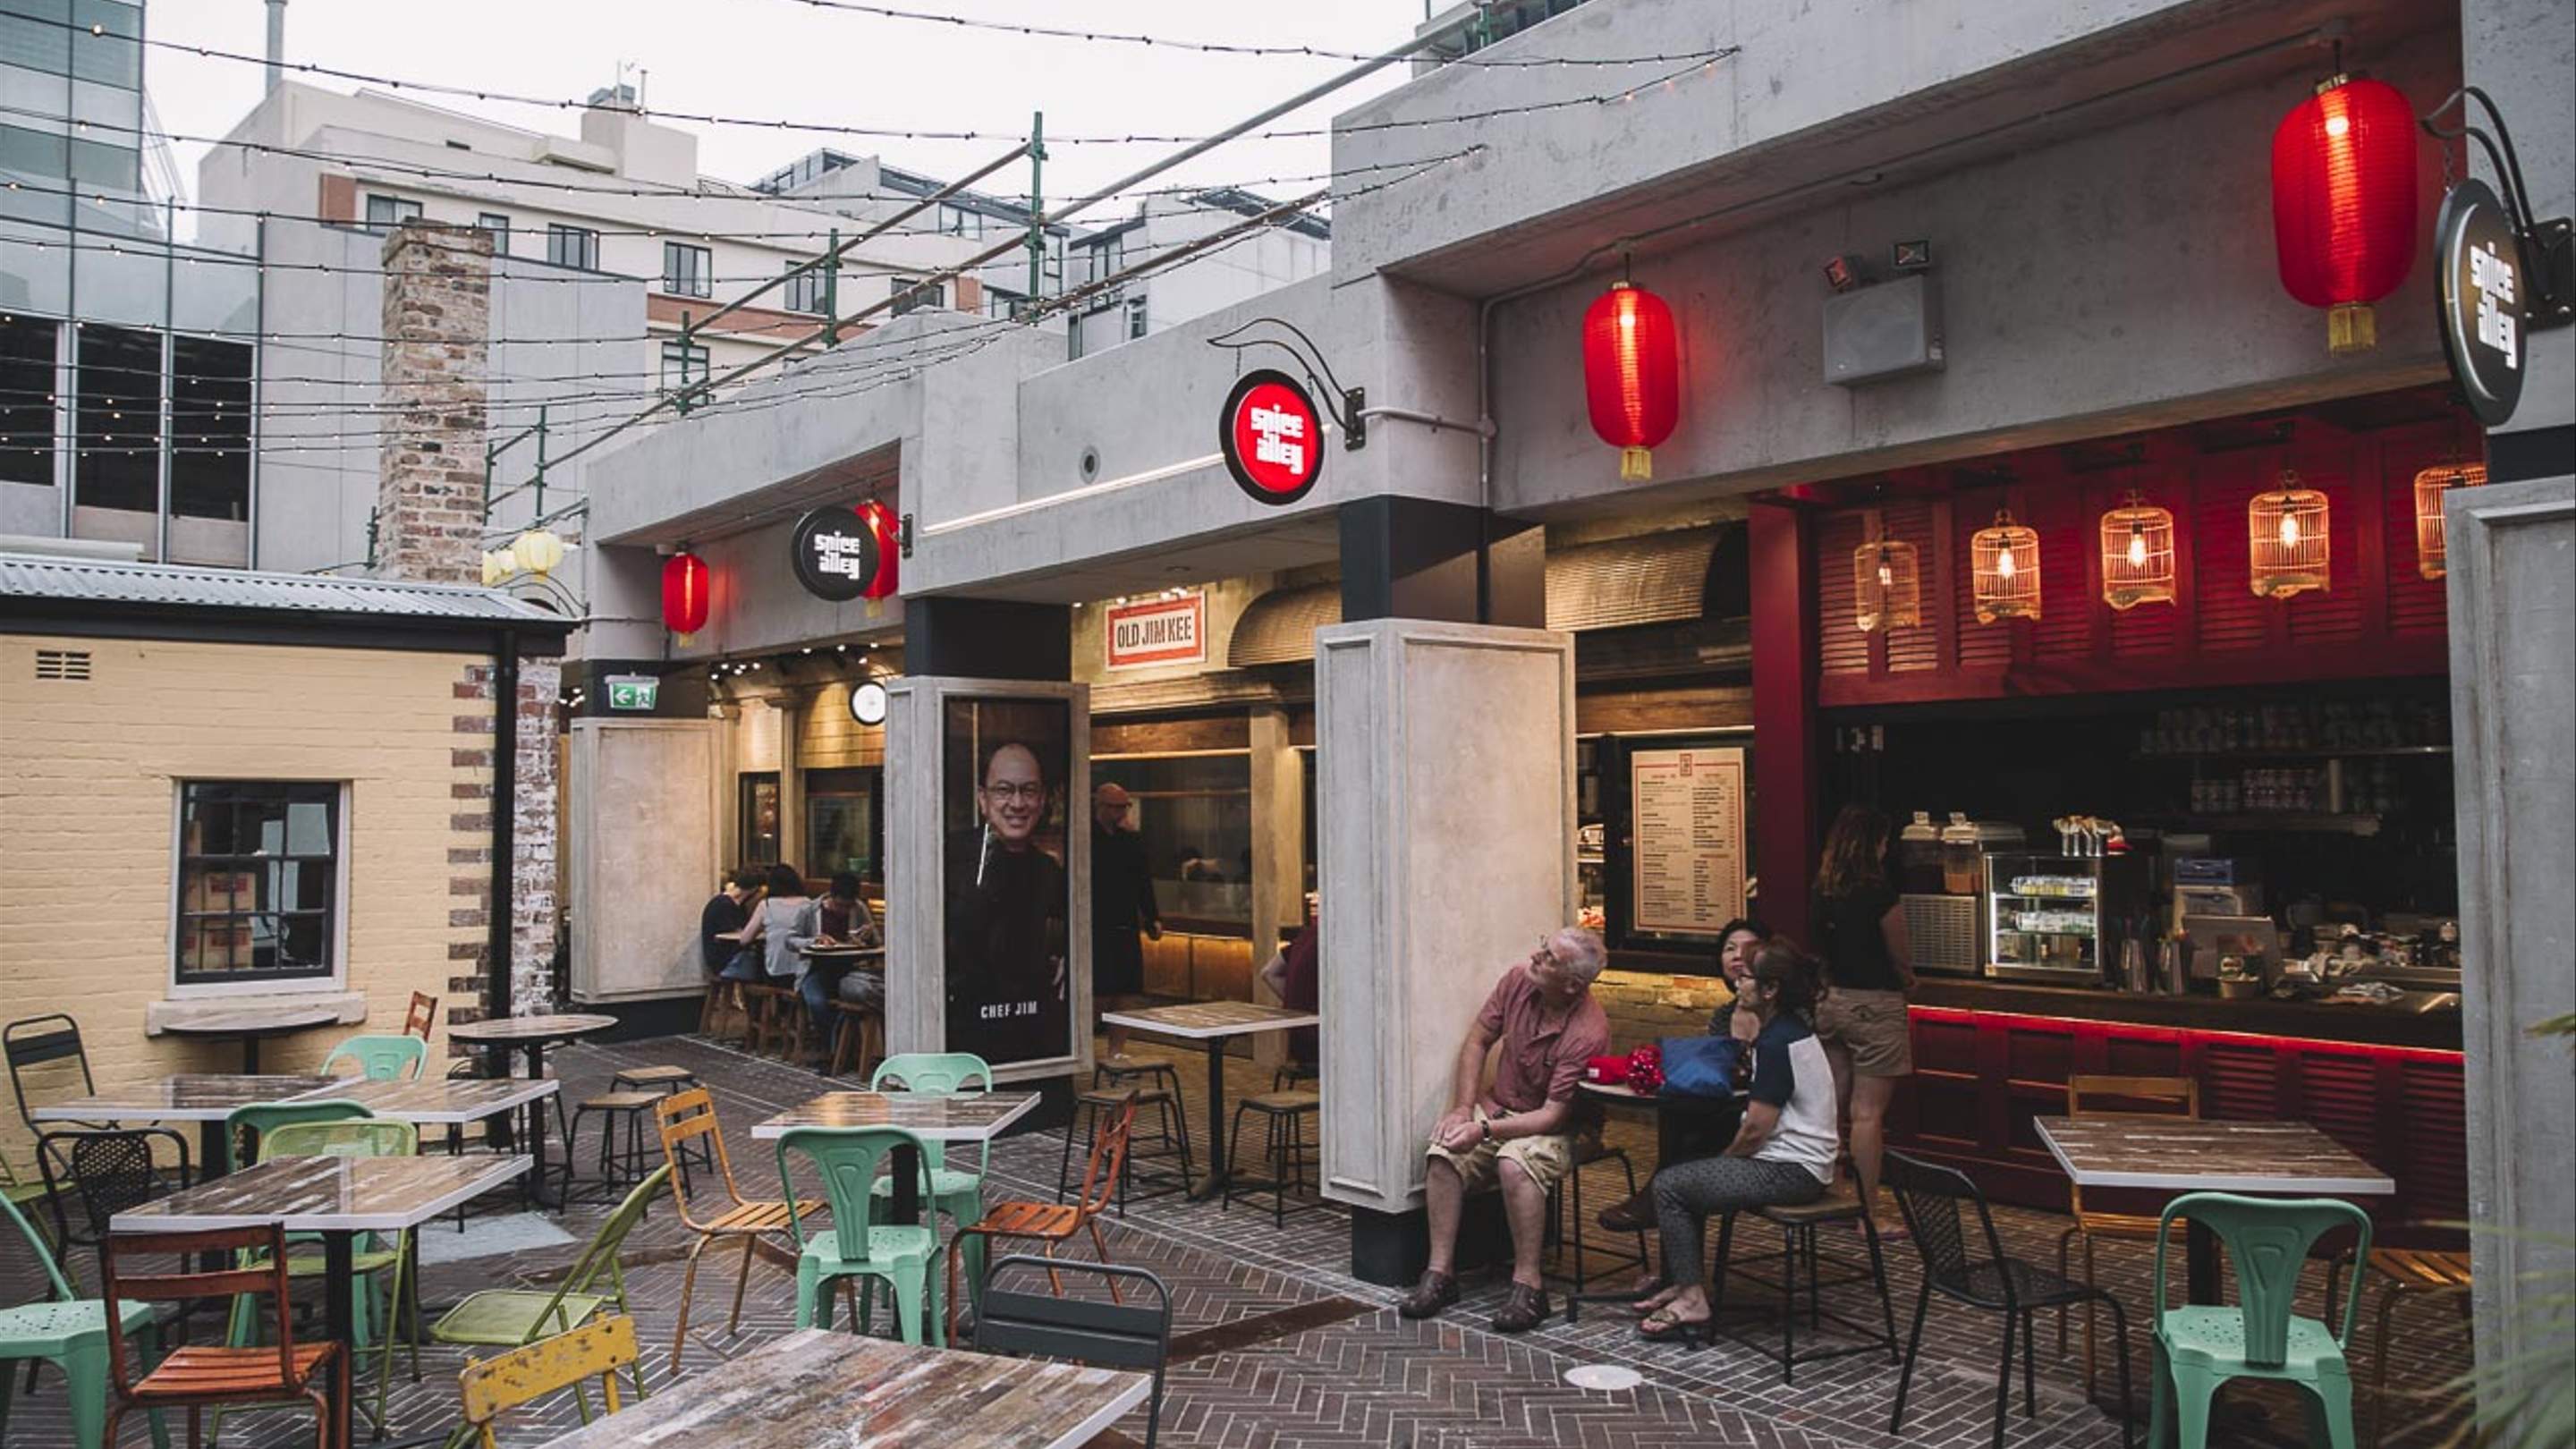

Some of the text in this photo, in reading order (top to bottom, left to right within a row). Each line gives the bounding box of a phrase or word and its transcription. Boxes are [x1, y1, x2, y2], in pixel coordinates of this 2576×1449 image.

[2470, 242, 2514, 304] spice
[2477, 292, 2517, 370] alley
[1250, 403, 1303, 437] spice
[1256, 434, 1303, 474] alley
[814, 530, 860, 555] spice
[818, 553, 860, 580] alley
[1117, 615, 1191, 648] OLD JIM KEE
[980, 1001, 1037, 1019] CHEF JIM
